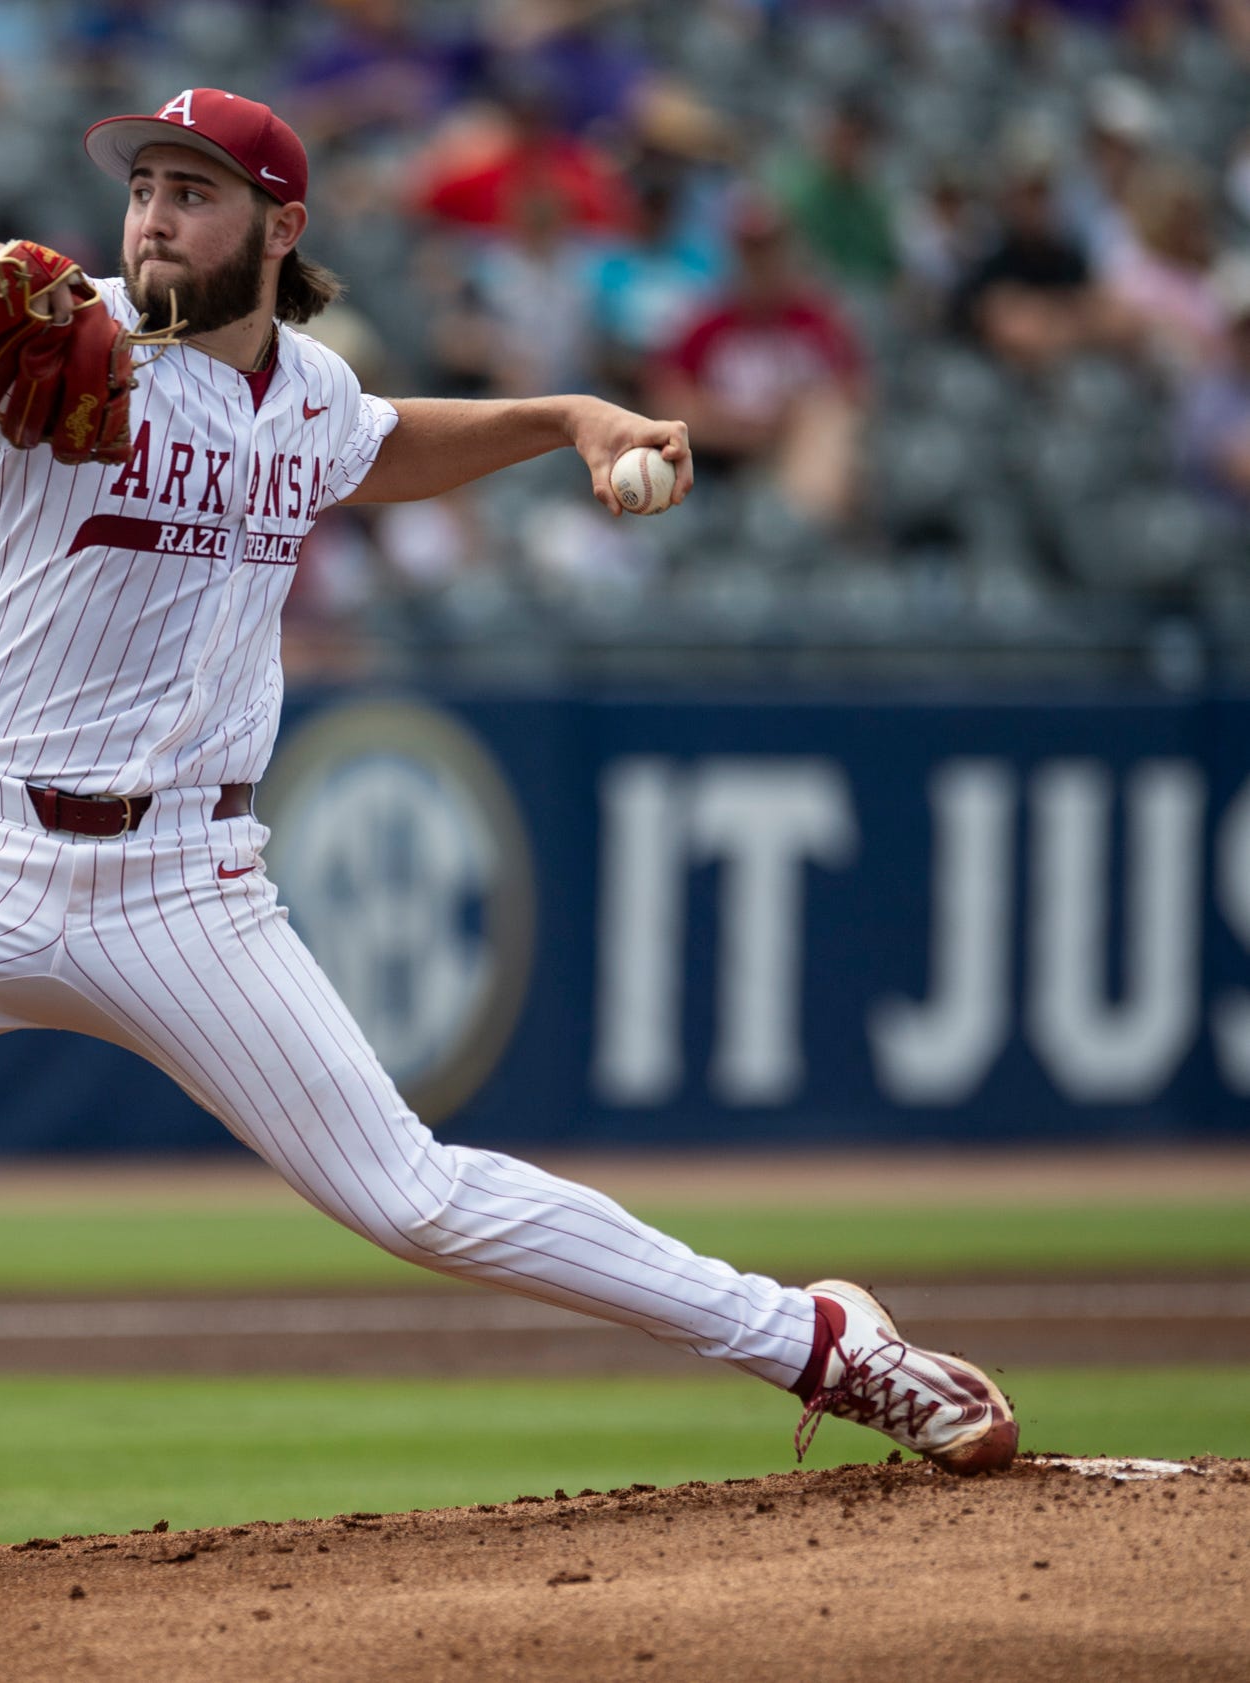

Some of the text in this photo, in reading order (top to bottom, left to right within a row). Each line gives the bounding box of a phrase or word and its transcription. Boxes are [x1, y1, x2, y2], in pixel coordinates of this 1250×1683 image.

[158, 89, 196, 127] A
[109, 420, 335, 522] ARKANSA
[597, 760, 851, 1101] IT
